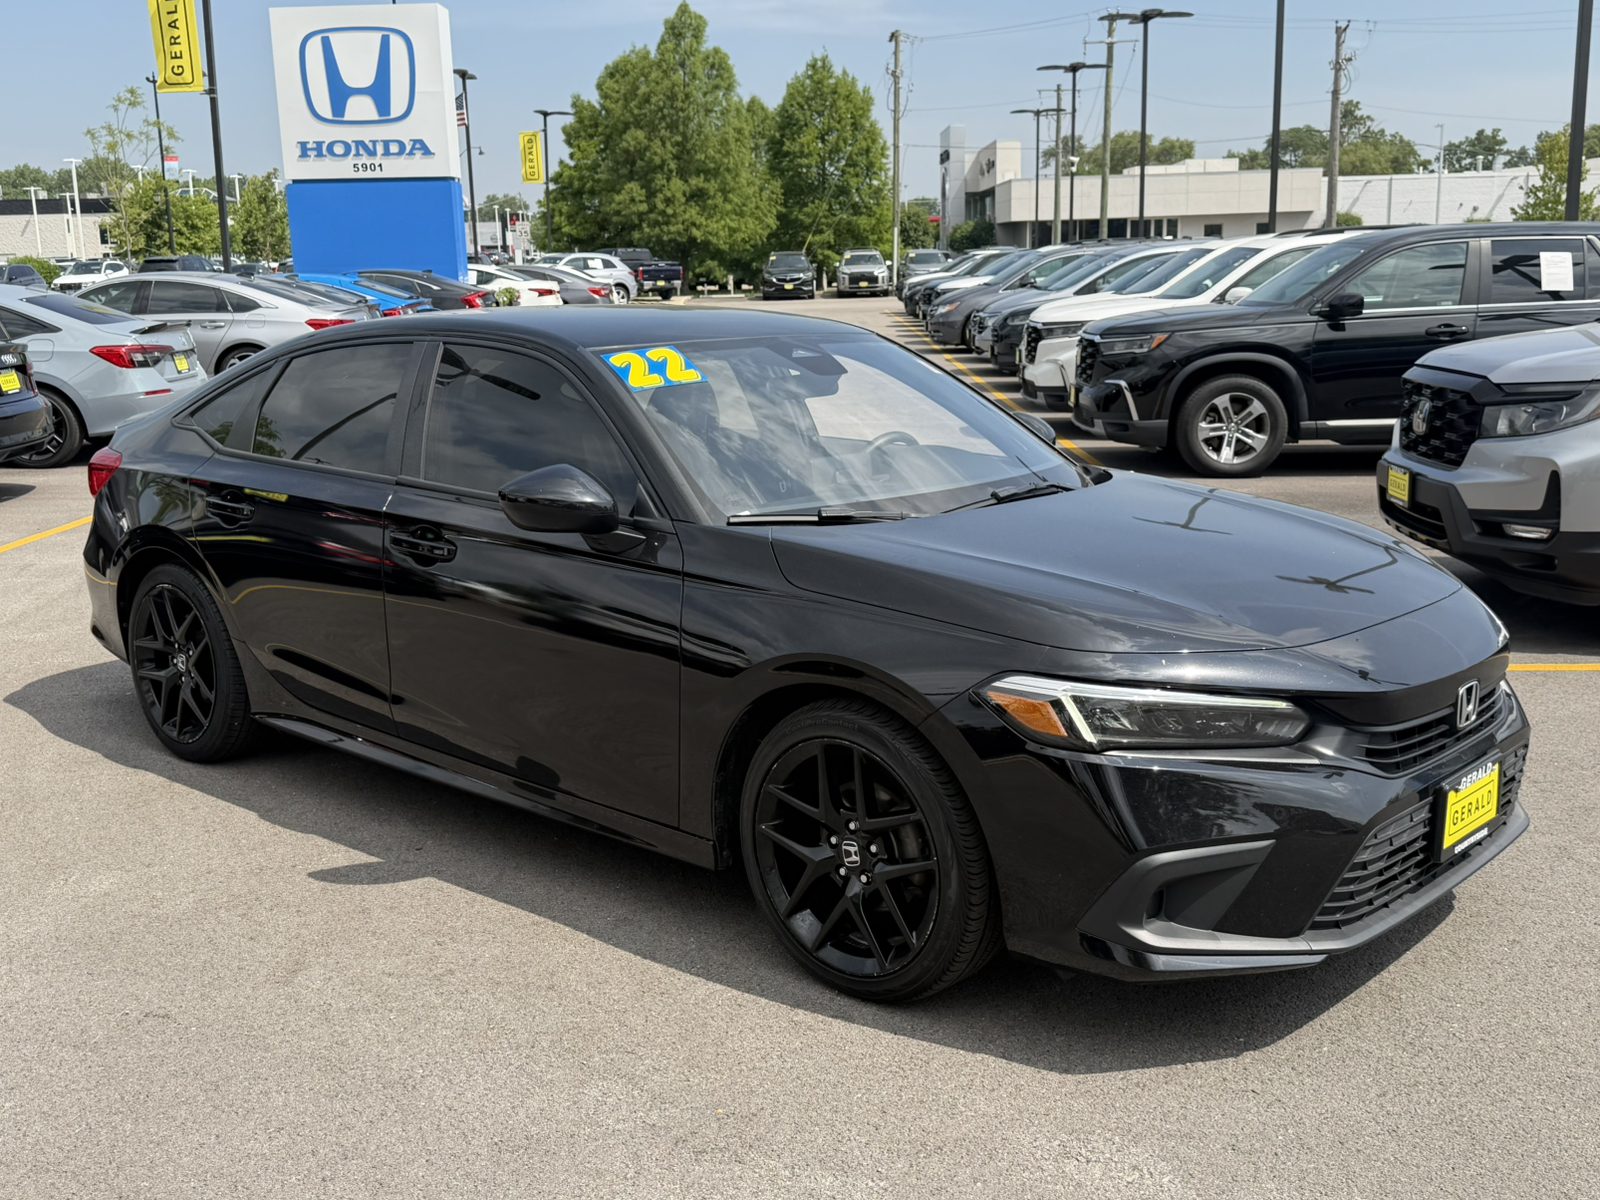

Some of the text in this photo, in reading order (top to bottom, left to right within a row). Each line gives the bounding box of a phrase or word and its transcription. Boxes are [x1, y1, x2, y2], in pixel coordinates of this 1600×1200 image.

[165, 0, 185, 77] GERAL
[296, 139, 436, 159] HONDA
[353, 163, 384, 173] 5901
[526, 137, 536, 177] GERALD
[609, 347, 702, 389] 22
[1459, 762, 1493, 790] GERALD
[1452, 789, 1492, 827] GERALD
